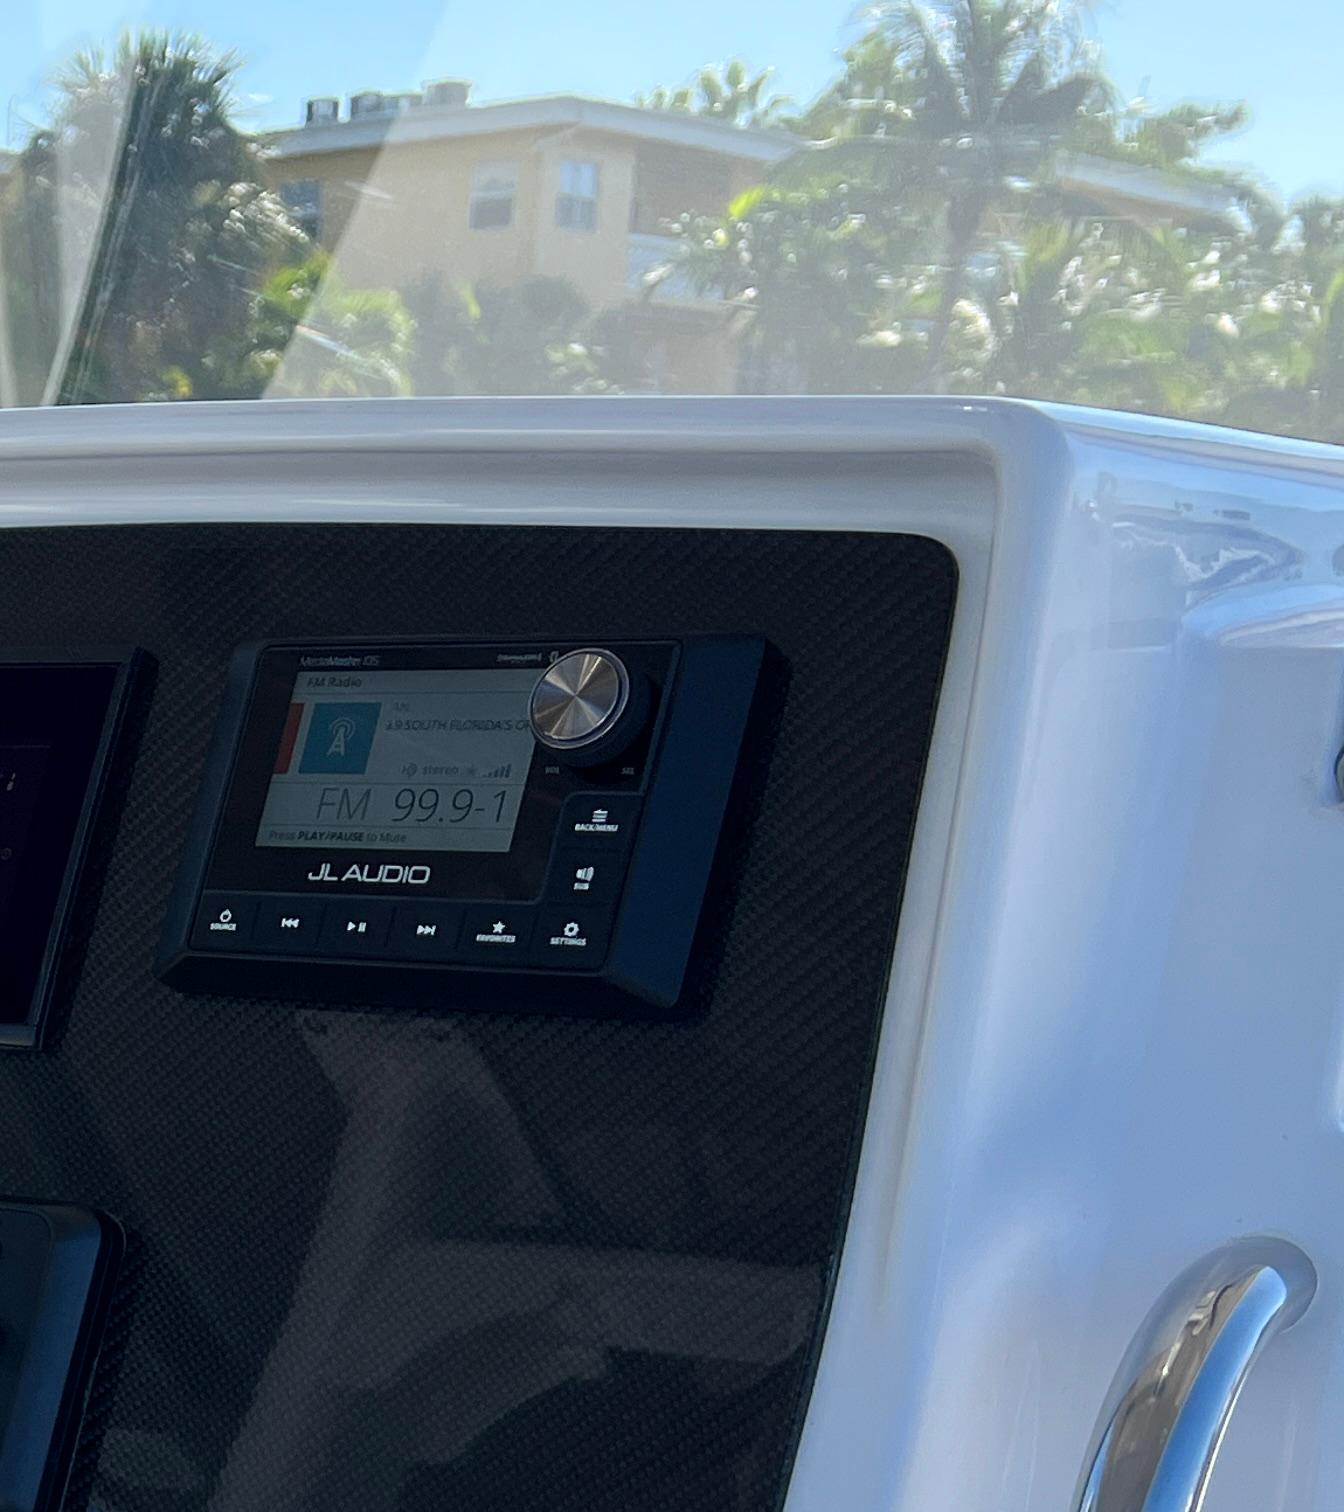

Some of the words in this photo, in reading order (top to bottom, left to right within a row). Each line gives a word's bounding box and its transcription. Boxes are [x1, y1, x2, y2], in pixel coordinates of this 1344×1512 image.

[327, 676, 362, 688] Radio
[403, 719, 447, 731] SOUTH
[422, 764, 459, 777] stereo
[316, 787, 372, 821] FM
[391, 788, 508, 824] 99.9-1
[297, 830, 365, 842] PLAY/PAUSE
[307, 862, 338, 883] JL
[340, 864, 431, 885] AUDIO
